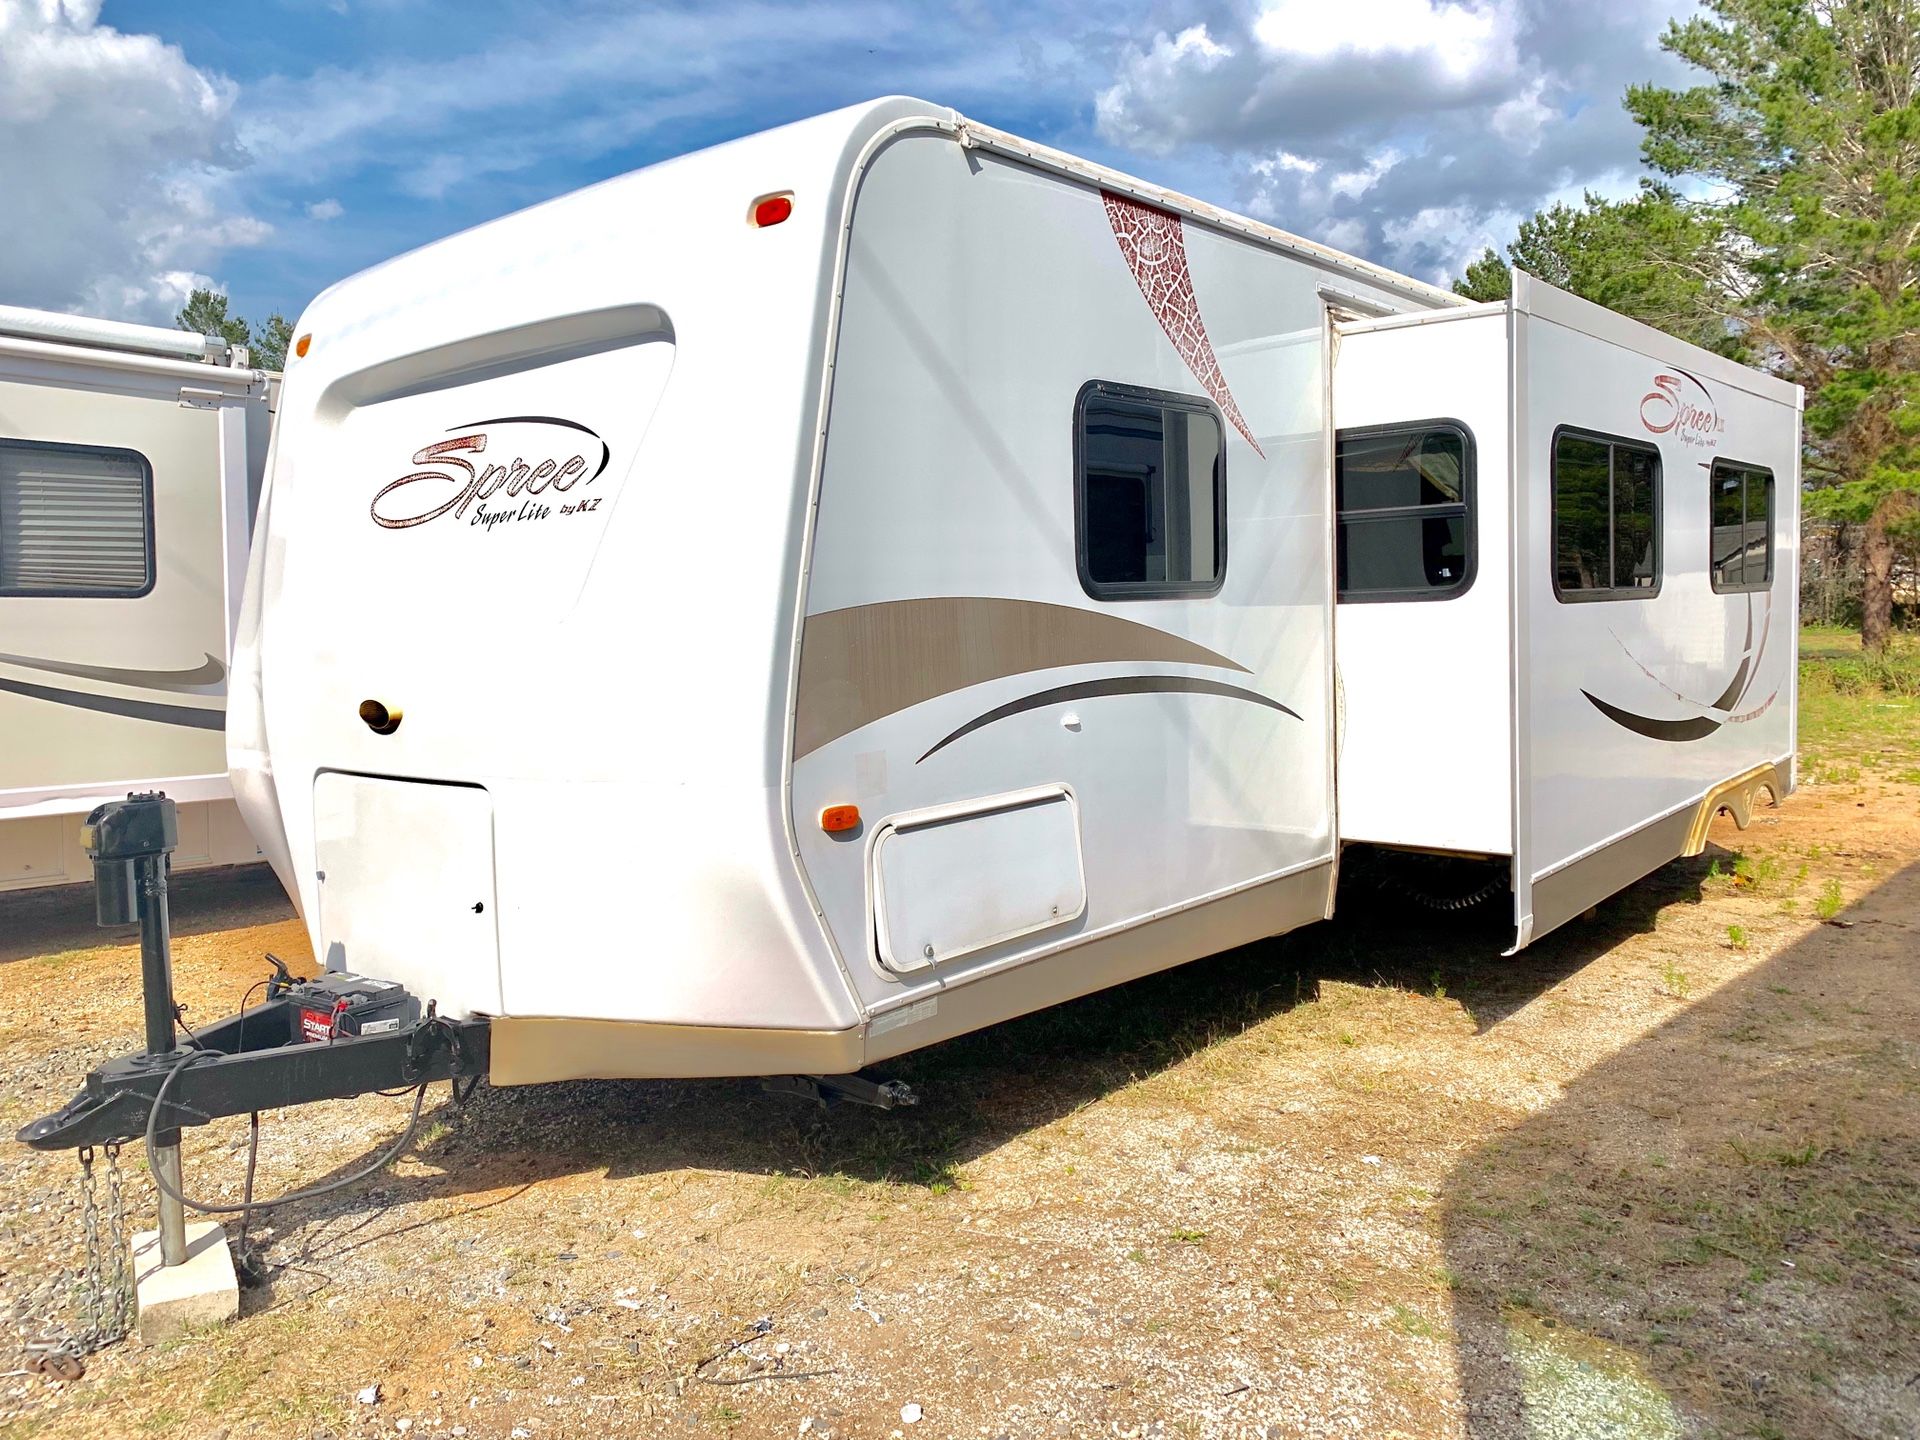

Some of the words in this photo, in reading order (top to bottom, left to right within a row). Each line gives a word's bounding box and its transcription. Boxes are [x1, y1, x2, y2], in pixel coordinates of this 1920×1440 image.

[1640, 375, 1712, 436] Spree
[370, 434, 589, 529] Spree
[303, 1018, 331, 1034] START
